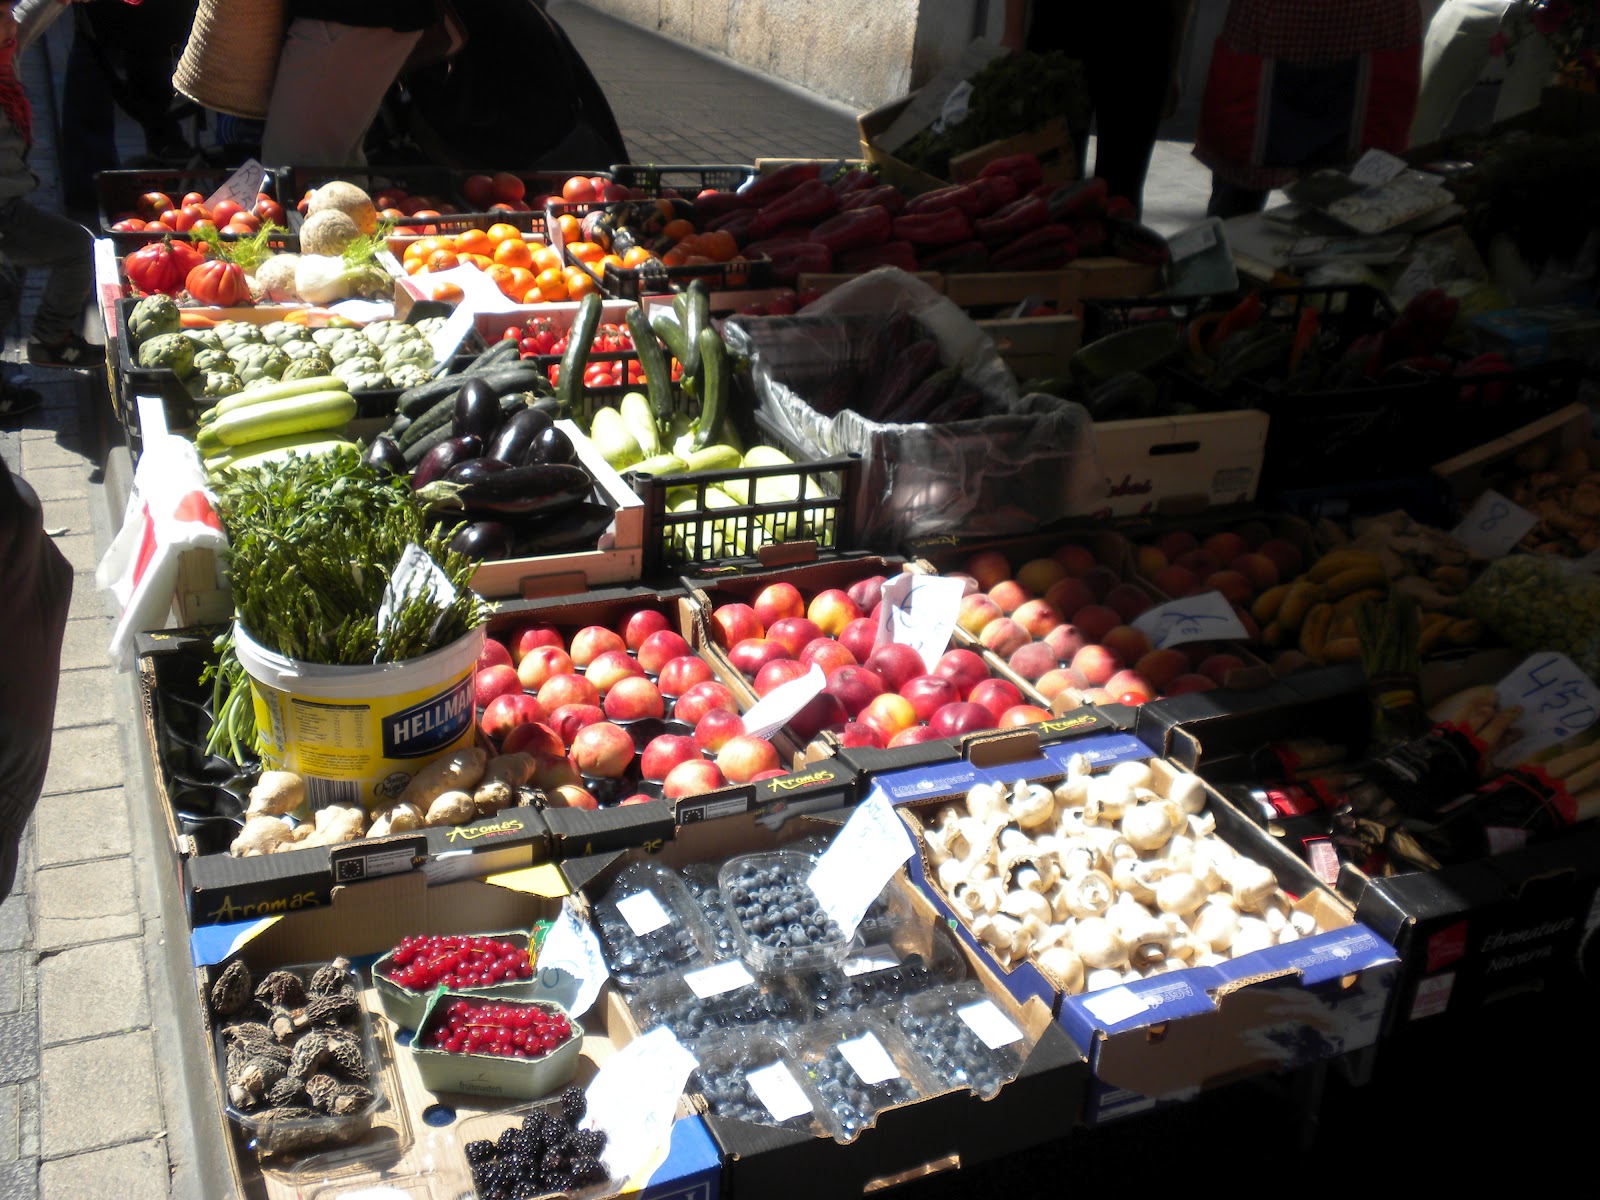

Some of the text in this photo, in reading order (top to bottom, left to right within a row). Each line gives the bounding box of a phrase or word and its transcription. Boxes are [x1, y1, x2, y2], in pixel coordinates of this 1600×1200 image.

[768, 770, 835, 793] Aromas
[445, 819, 524, 843] Aromas
[208, 889, 322, 924] Aromas
